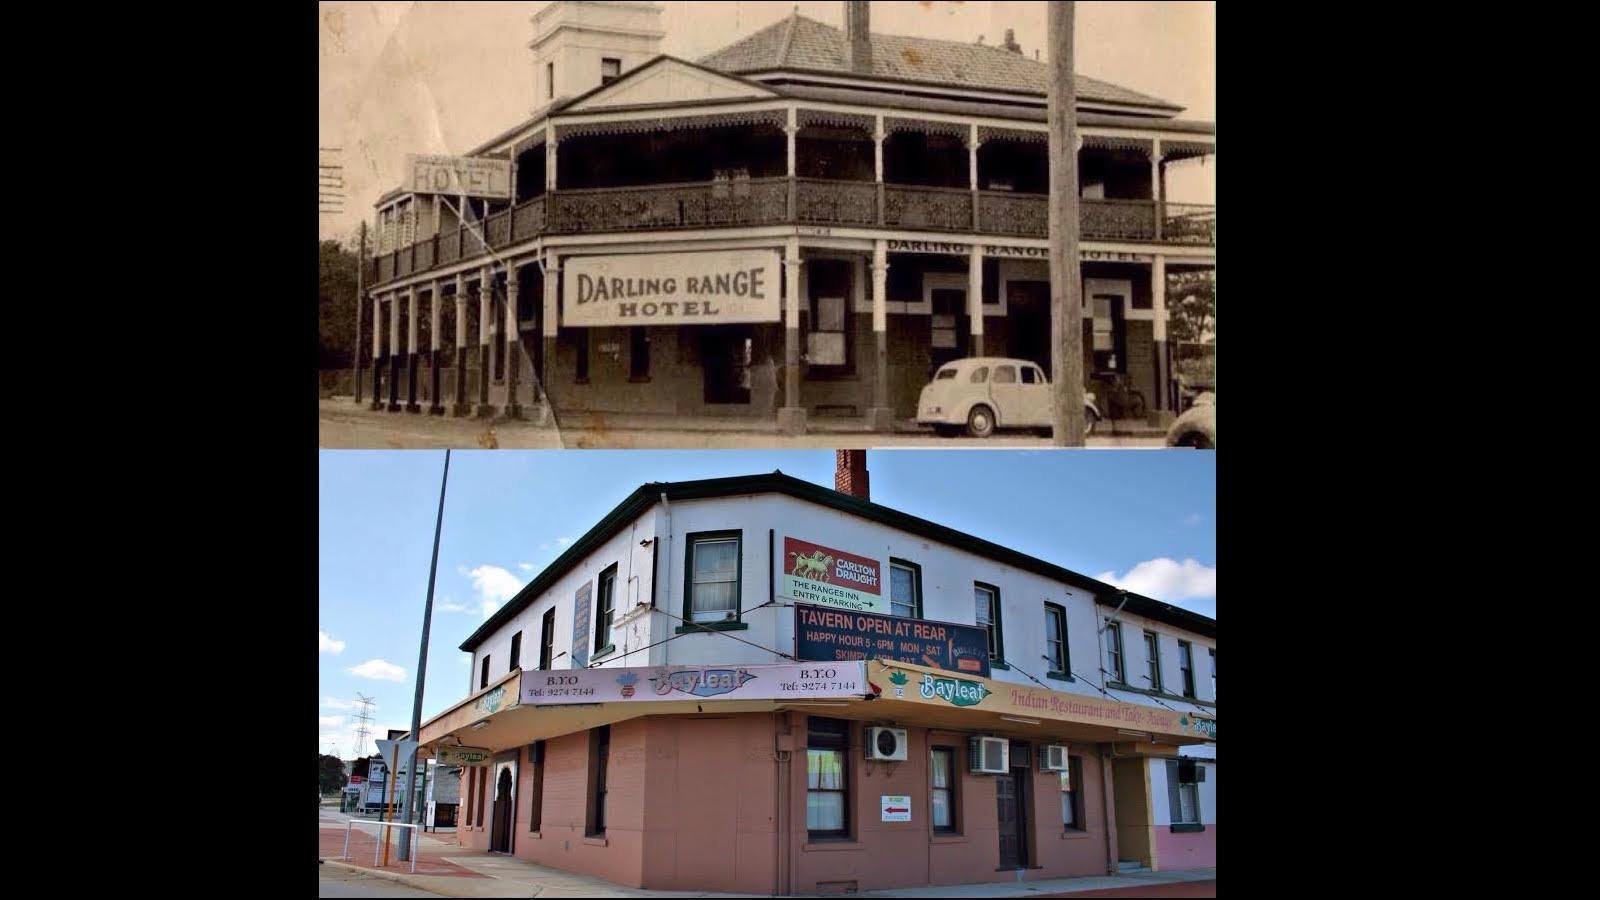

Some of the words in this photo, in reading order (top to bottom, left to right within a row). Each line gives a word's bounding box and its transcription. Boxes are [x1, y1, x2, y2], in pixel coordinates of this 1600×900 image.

[413, 166, 507, 194] HOTEL
[887, 240, 965, 254] DARLING
[577, 273, 677, 305] DARLING
[686, 267, 765, 299] RANGE
[619, 302, 719, 317] HOTEL
[835, 568, 878, 587] DRAUGHT
[836, 559, 876, 577] CARLTON
[792, 580, 810, 589] THE
[811, 583, 844, 598] RANGES
[845, 592, 859, 601] INN
[793, 590, 820, 601] ENTRY
[828, 597, 863, 611] PARKING
[800, 609, 853, 630] TAVERN
[857, 616, 892, 635] OPEN
[895, 621, 911, 637] AT
[913, 624, 946, 641] REAR
[806, 631, 837, 644] HAPPY
[838, 634, 864, 647] HOUR
[865, 639, 871, 648] 5
[877, 640, 894, 651] 6PM
[900, 642, 919, 654] MON
[926, 645, 941, 655] SAT
[835, 649, 868, 661] SKIMPY
[547, 676, 579, 686] B.Y.O
[655, 667, 748, 696] Bayleaf
[800, 669, 837, 679] B.Y.O
[529, 689, 545, 697] Tel:
[547, 688, 570, 697] 9274
[572, 688, 594, 697] 7144
[780, 682, 799, 692] Tel:
[801, 681, 827, 691] 9274
[830, 681, 856, 691] 7144
[920, 672, 985, 700] Bayleaf
[1011, 689, 1048, 709] Indian
[1050, 696, 1103, 717] Restaurant
